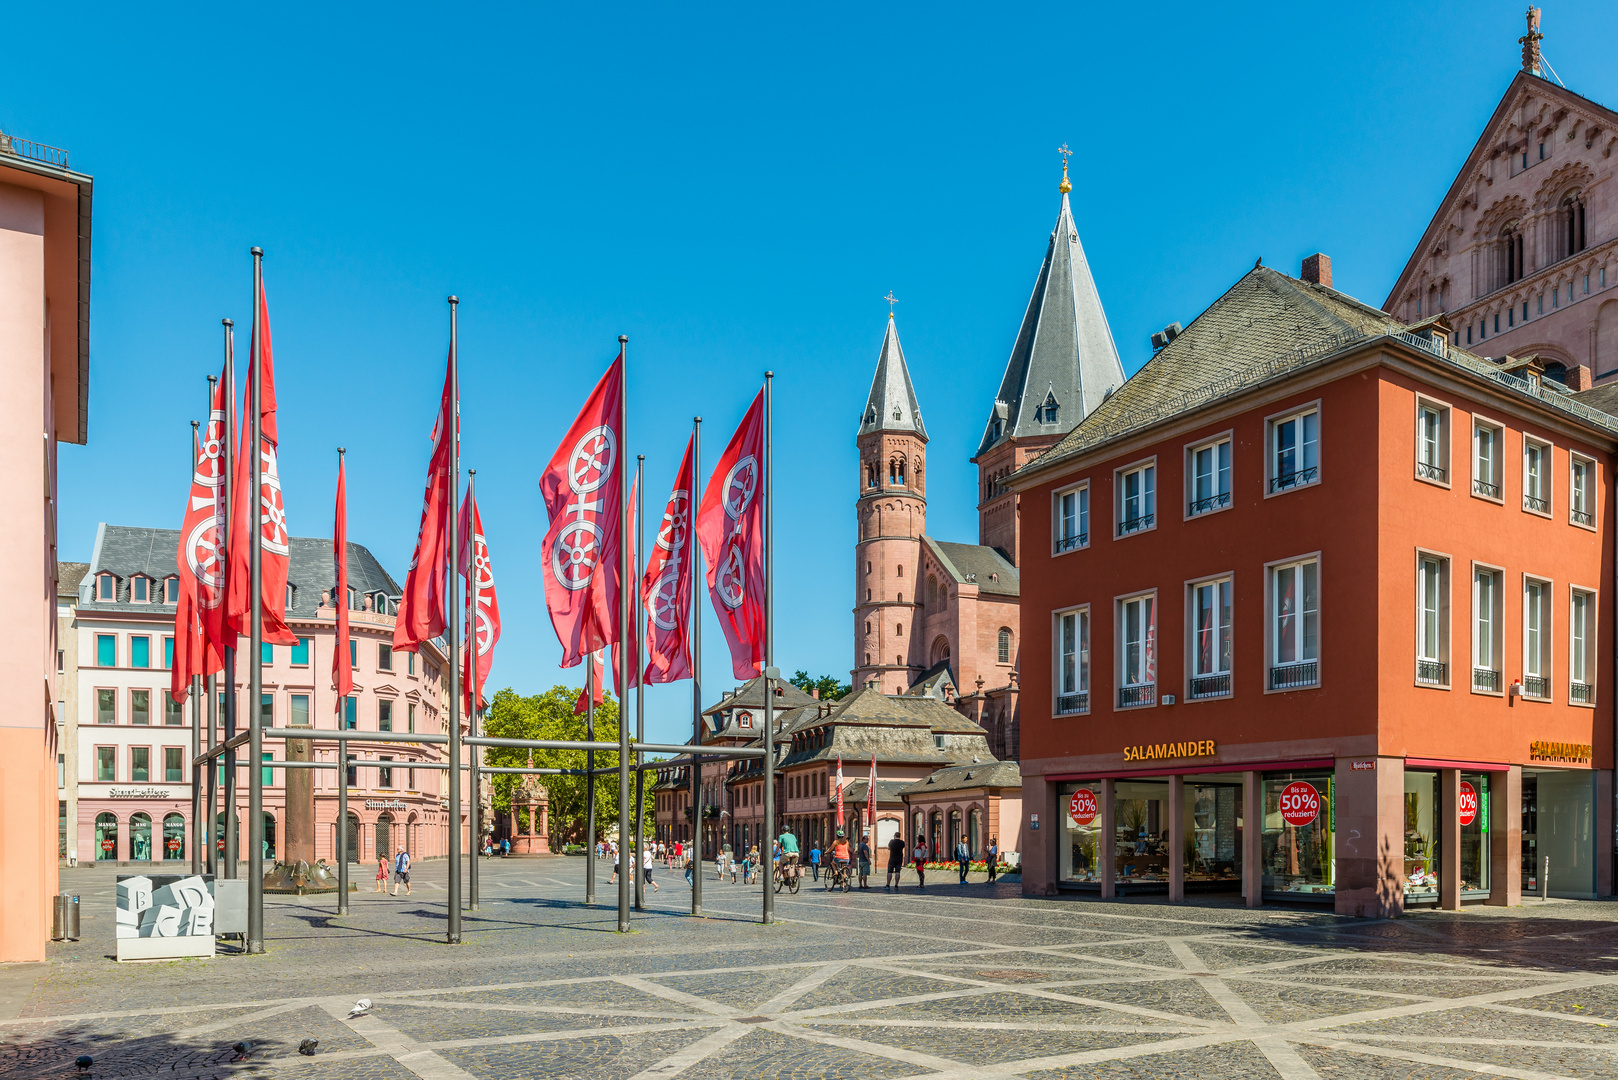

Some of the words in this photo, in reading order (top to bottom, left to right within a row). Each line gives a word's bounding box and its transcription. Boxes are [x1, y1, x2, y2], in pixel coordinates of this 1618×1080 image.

[1123, 740, 1215, 761] SALAMANDER
[1530, 741, 1592, 760] SALAMANDER
[1071, 799, 1096, 812] 50%
[1282, 794, 1317, 810] 50%
[1460, 794, 1475, 809] 0%
[1284, 810, 1316, 818] reduziert!
